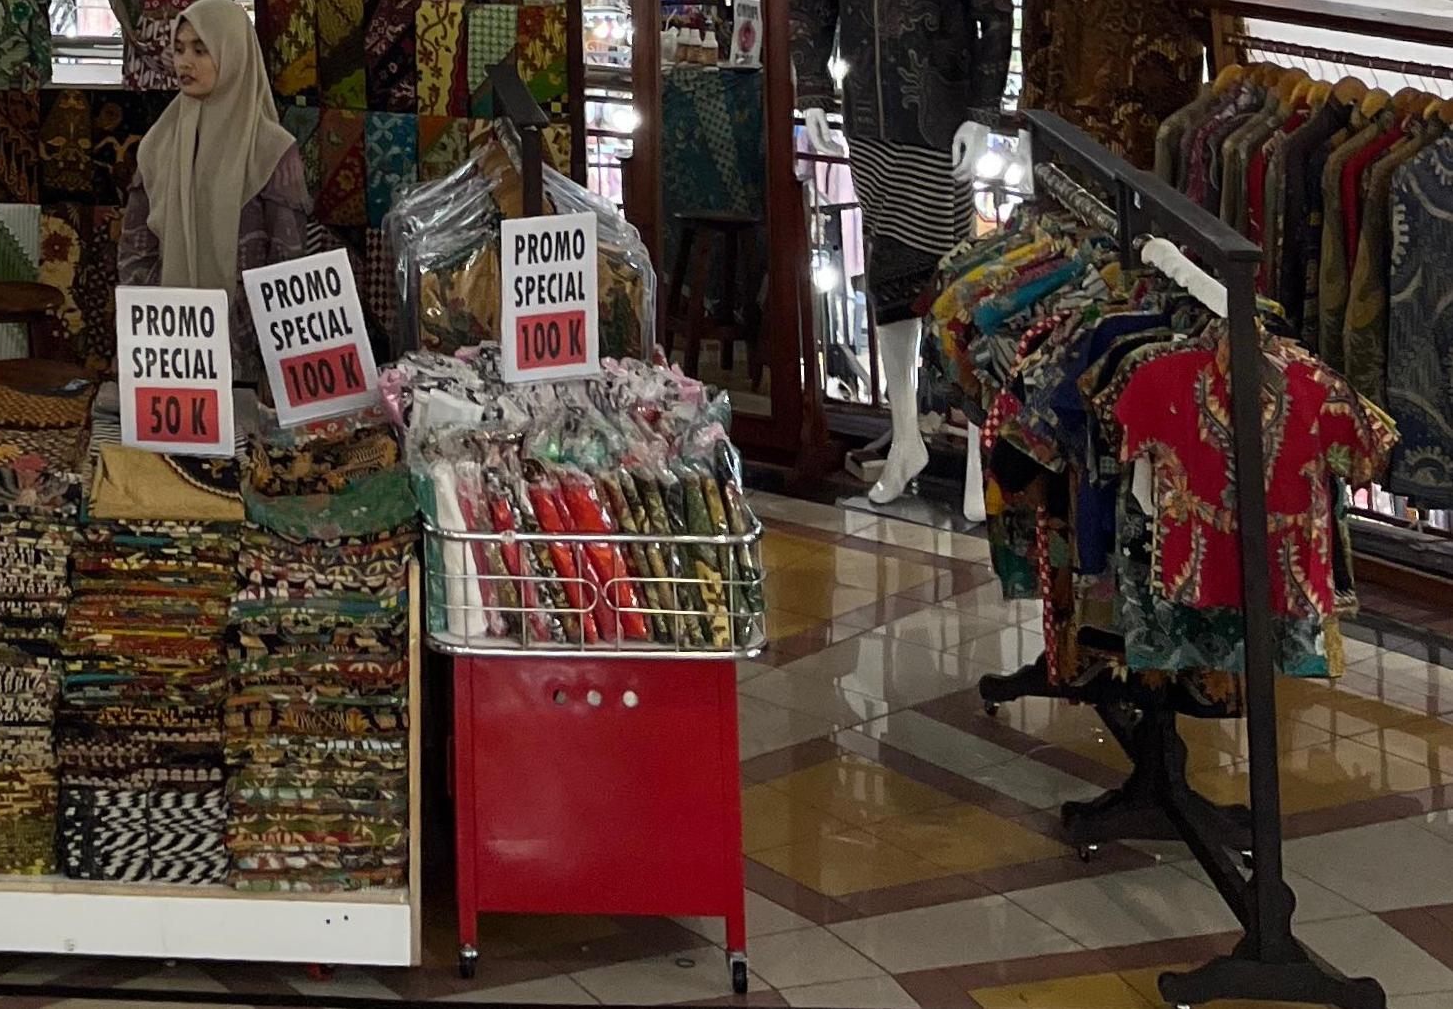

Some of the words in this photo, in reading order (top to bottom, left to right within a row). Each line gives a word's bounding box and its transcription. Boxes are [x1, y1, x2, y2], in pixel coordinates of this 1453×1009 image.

[514, 228, 585, 266] PROMO
[260, 266, 341, 313] PROMO
[514, 271, 586, 308] SPECIAL
[131, 304, 215, 338] PROMO
[270, 306, 353, 351] SPECIAL
[521, 320, 561, 362] 100
[568, 318, 582, 356] K
[132, 347, 217, 379] SPECIAL
[287, 358, 336, 400] 100
[340, 352, 360, 389] K
[150, 395, 181, 435] 50
[191, 397, 207, 435] K
